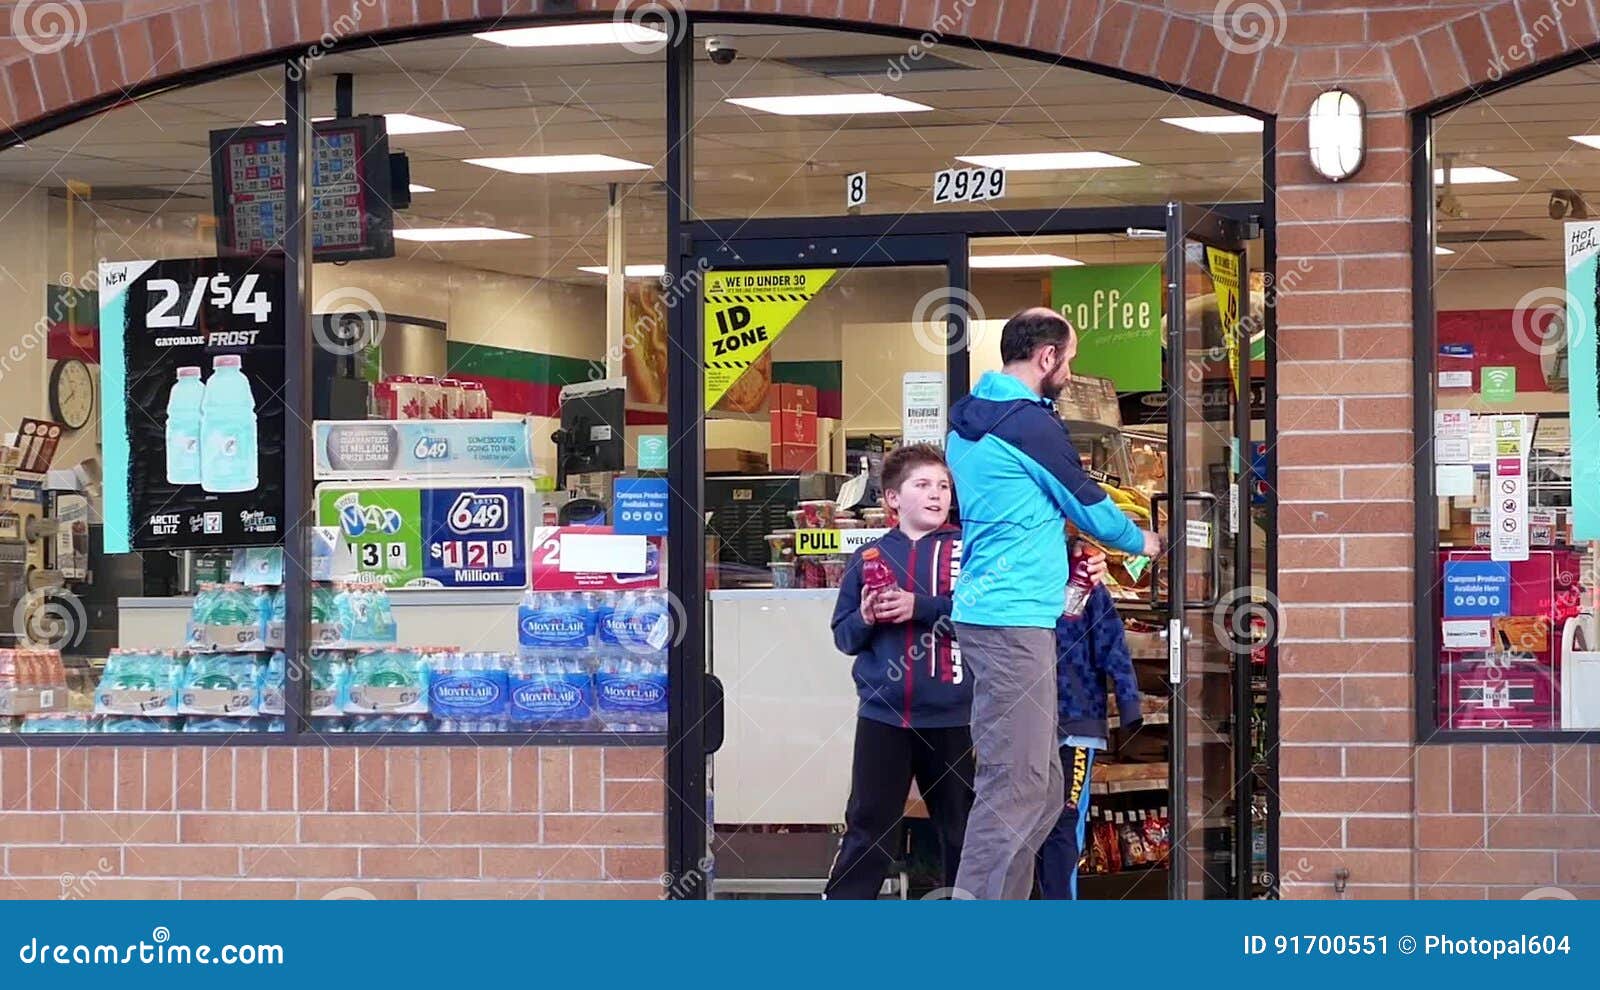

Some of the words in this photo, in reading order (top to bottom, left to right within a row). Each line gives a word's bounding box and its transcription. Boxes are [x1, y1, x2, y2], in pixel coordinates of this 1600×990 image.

[851, 175, 864, 203] 8
[935, 169, 1004, 201] 2929
[1571, 227, 1595, 243] HOT
[1571, 236, 1599, 256] DEAL
[105, 266, 128, 286] NEW
[725, 276, 741, 287] WE
[744, 276, 754, 287] ID
[757, 276, 791, 286] UNDER
[794, 275, 806, 285] 30
[145, 272, 272, 328] 2/$4
[1061, 289, 1150, 330] coffee
[715, 305, 751, 335] ID
[155, 335, 205, 347] GATORADE
[208, 330, 260, 347] FROST
[712, 325, 769, 357] ZONE
[149, 514, 180, 525] ARCTIC
[341, 504, 399, 535] MAX
[153, 524, 177, 535] BLITZ
[800, 533, 838, 550] PULL
[846, 537, 882, 545] WELCO
[455, 570, 500, 582] Million
[1477, 575, 1506, 583] Products
[528, 620, 585, 633] MONTCLAIR
[237, 631, 255, 643] G2
[439, 686, 493, 698] MONTCLAIR
[520, 691, 574, 704] MONTCLAIR
[604, 685, 659, 699] MONTCLAIR
